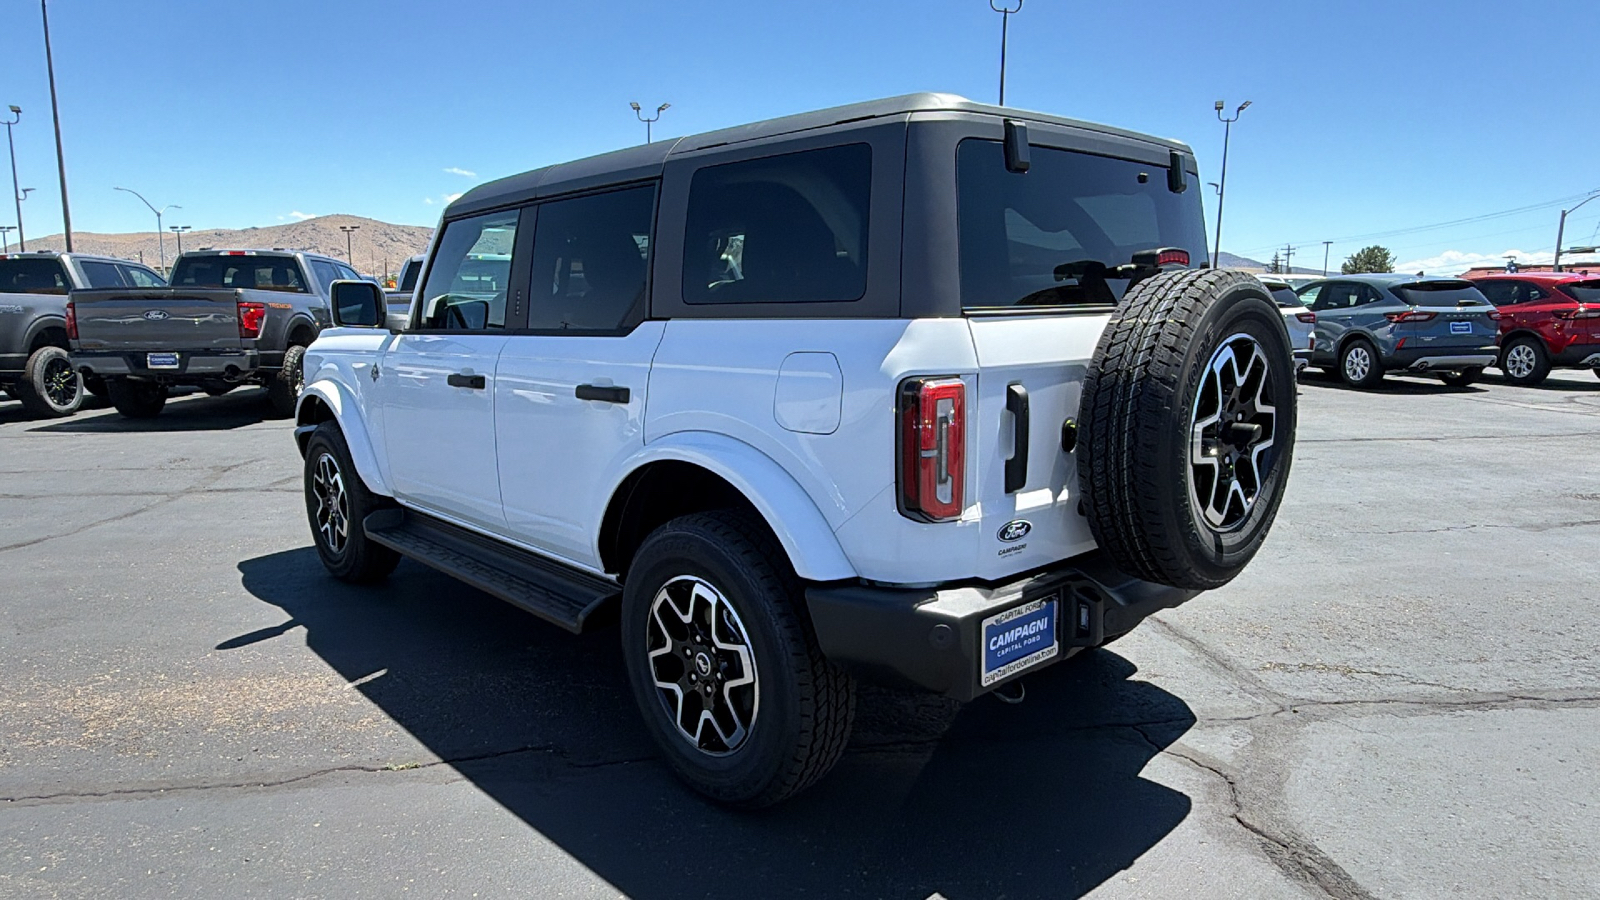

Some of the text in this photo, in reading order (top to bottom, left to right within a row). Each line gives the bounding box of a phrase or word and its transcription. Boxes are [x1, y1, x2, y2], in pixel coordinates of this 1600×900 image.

[1004, 522, 1029, 539] Ford
[997, 542, 1027, 556] CAMPAGNI
[999, 609, 1024, 622] CAPITAL
[989, 616, 1048, 651] CAMPAGNI
[996, 634, 1041, 657] CAPITAL FORD
[984, 646, 1057, 684] capitalfordonline.com
